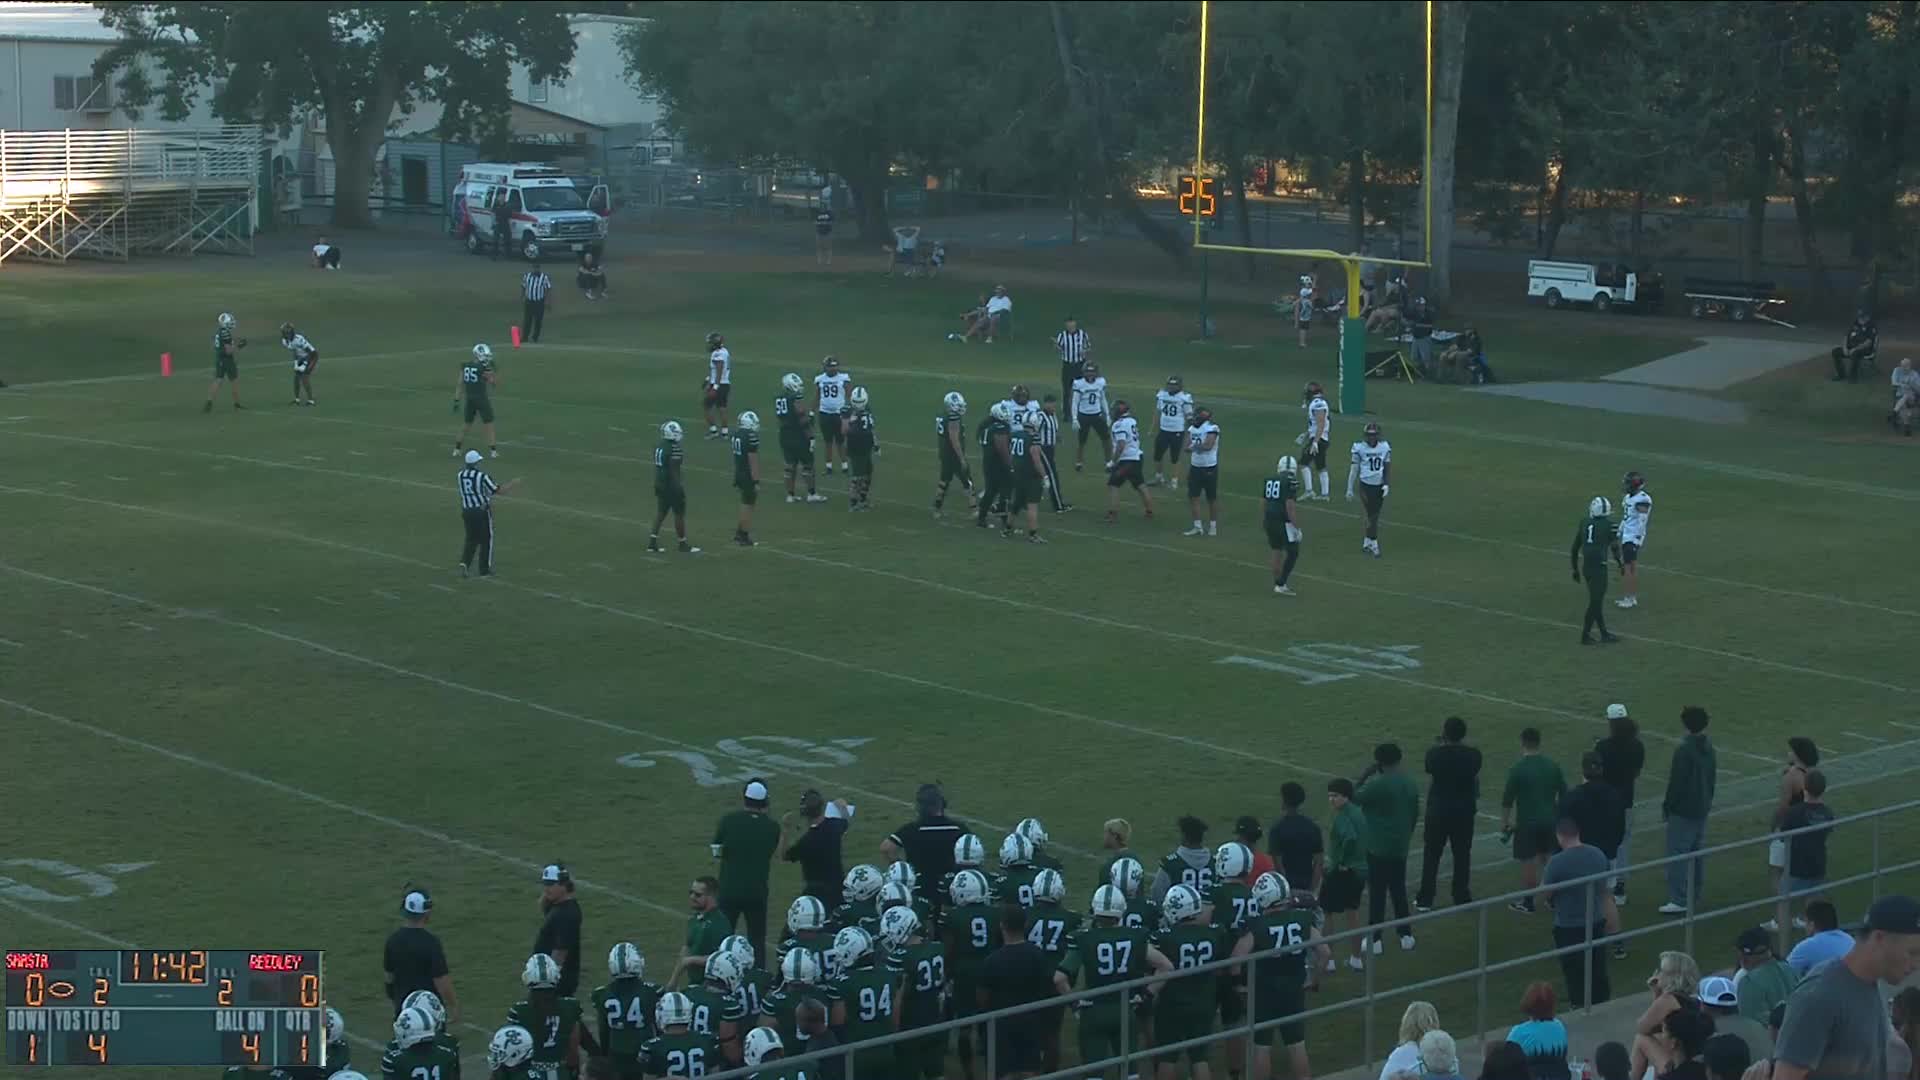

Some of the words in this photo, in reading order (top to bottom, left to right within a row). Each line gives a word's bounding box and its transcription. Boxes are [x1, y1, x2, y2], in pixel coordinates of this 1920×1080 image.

[1180, 177, 1216, 215] 25
[464, 367, 478, 382] 85
[823, 384, 838, 398] 89
[1367, 457, 1381, 471] 10
[1264, 480, 1280, 498] 88
[1587, 524, 1594, 543] 1
[971, 917, 988, 947] 9
[1028, 919, 1064, 950] 47
[1270, 923, 1303, 955] 76
[1098, 940, 1132, 975] 97
[1180, 942, 1213, 969] 62
[916, 955, 945, 991] 33
[604, 996, 645, 1030] 24
[859, 984, 892, 1021] 94
[666, 1047, 705, 1079] 26
